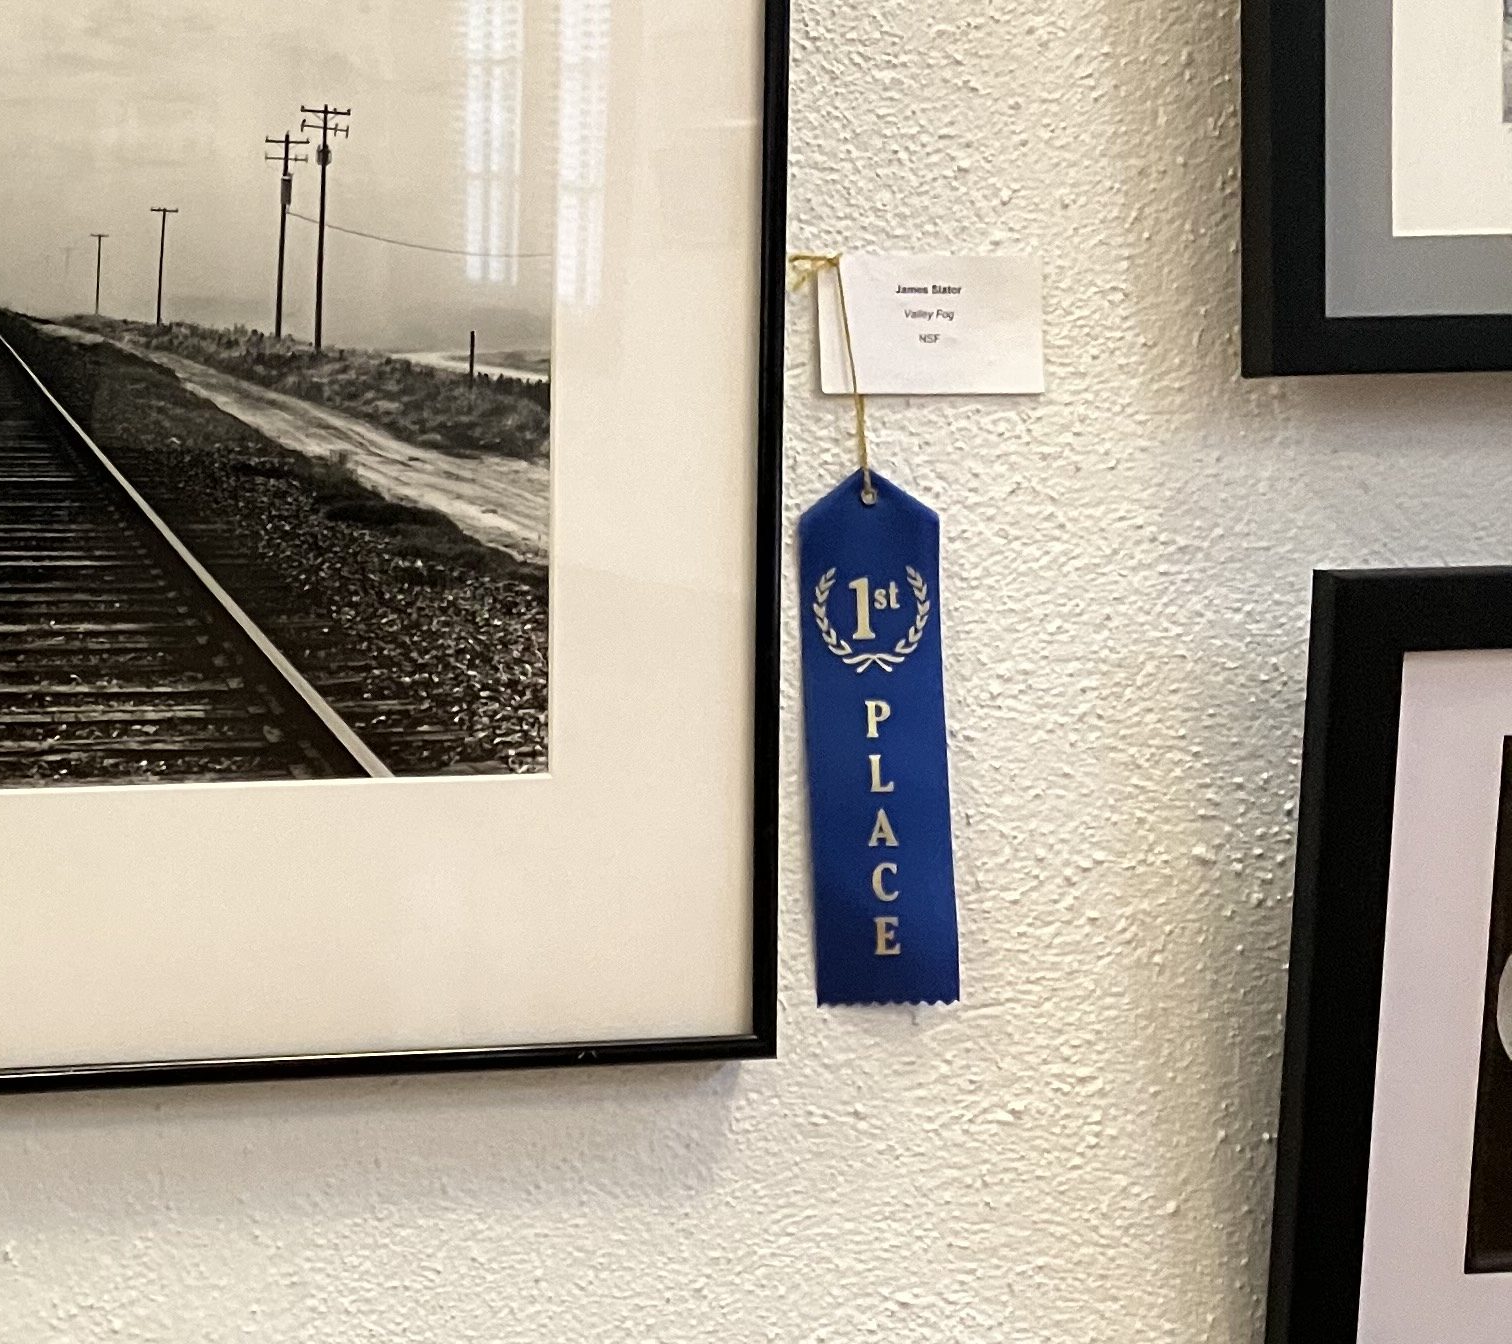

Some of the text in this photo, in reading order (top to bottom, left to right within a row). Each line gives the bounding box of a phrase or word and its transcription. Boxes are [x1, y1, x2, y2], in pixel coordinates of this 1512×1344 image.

[935, 308, 955, 321] Fog
[848, 576, 901, 640] 1st
[864, 699, 902, 957] PLACE
